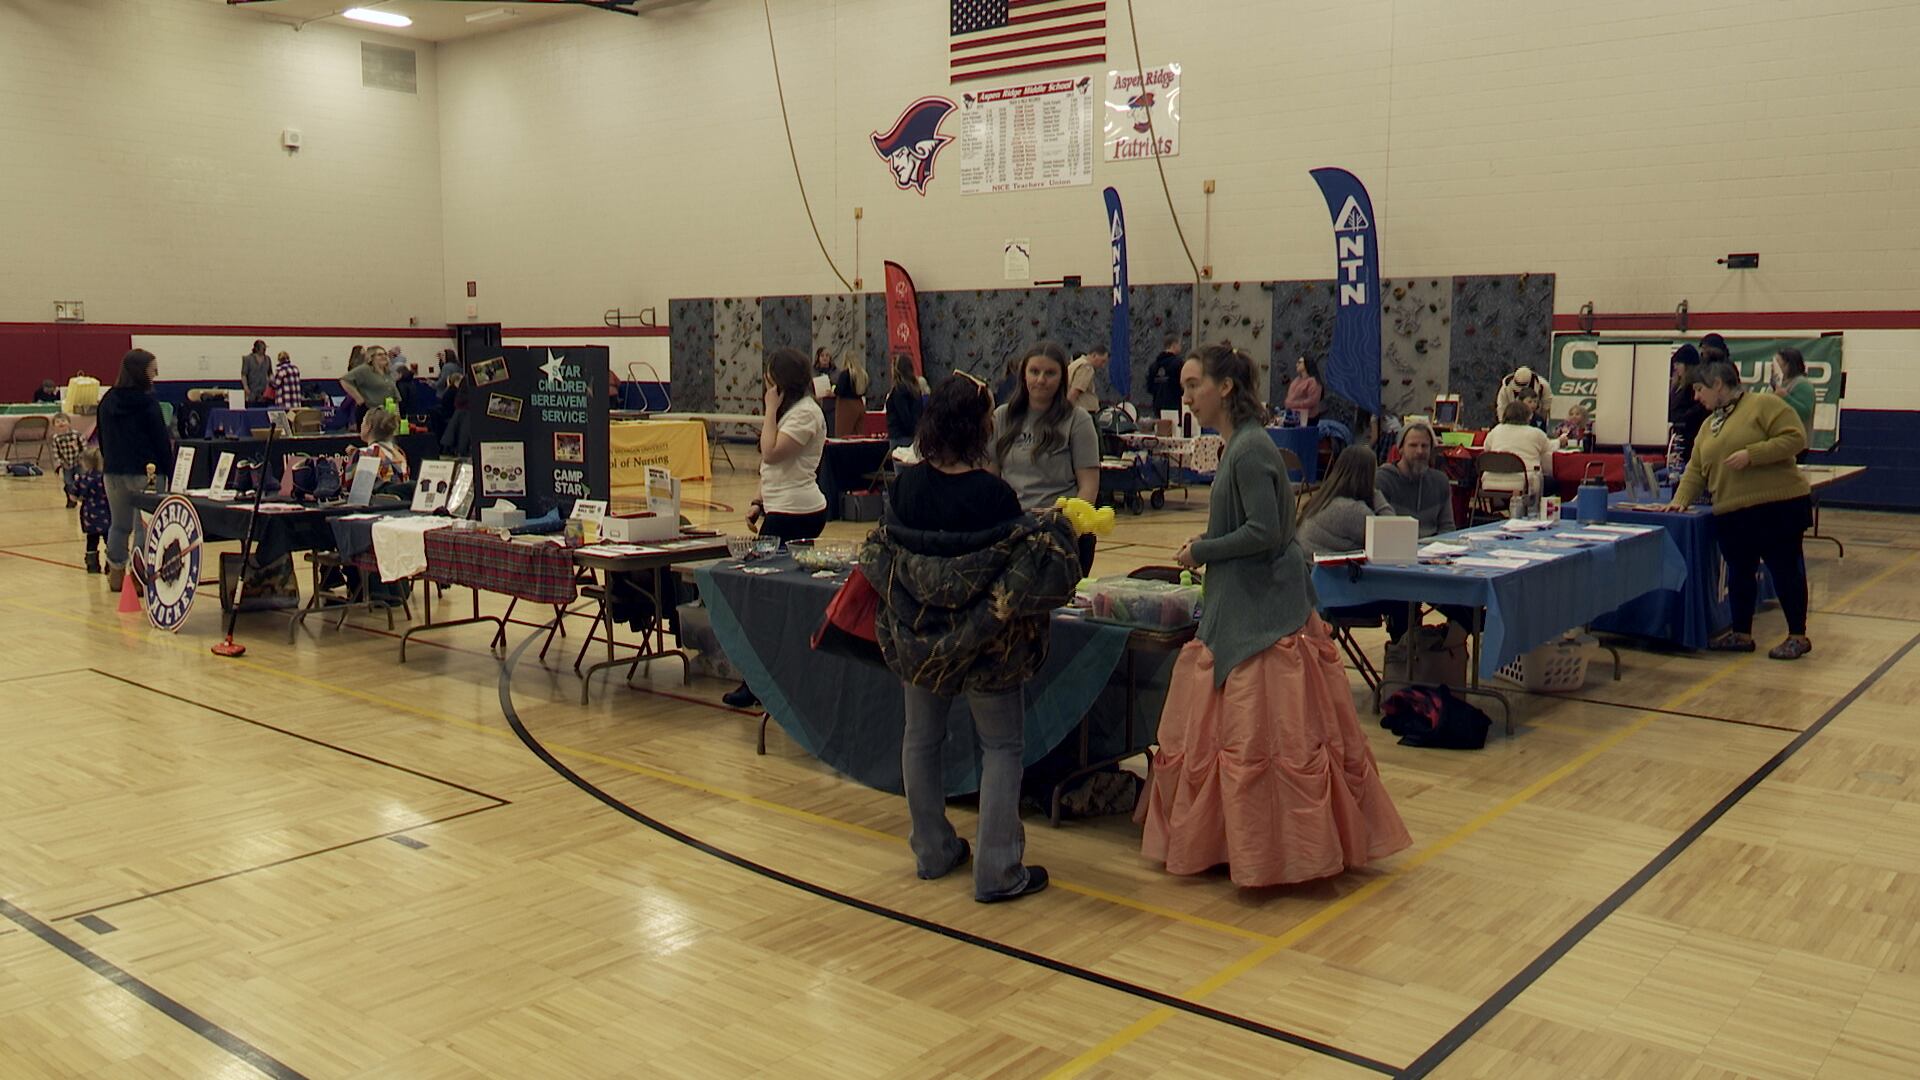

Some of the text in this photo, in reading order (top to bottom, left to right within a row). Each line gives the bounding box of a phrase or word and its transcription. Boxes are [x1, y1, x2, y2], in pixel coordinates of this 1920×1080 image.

[1113, 69, 1175, 92] Aspen Ridge
[980, 91, 1000, 102] Aspen
[1002, 88, 1022, 99] Ridge
[1048, 81, 1072, 92] School
[1113, 137, 1173, 160] Patriots
[992, 179, 1072, 192] NICE Teachers Union
[1112, 244, 1122, 306] NTN
[1339, 234, 1366, 306] NTN
[551, 365, 581, 378] STAR
[1559, 381, 1598, 396] SKI
[541, 409, 588, 424] SERVICE
[620, 457, 630, 469] of
[634, 455, 669, 468] Nursing
[553, 469, 584, 483] CAMP
[554, 482, 583, 496] STAR
[148, 503, 196, 565] SUPERIOR
